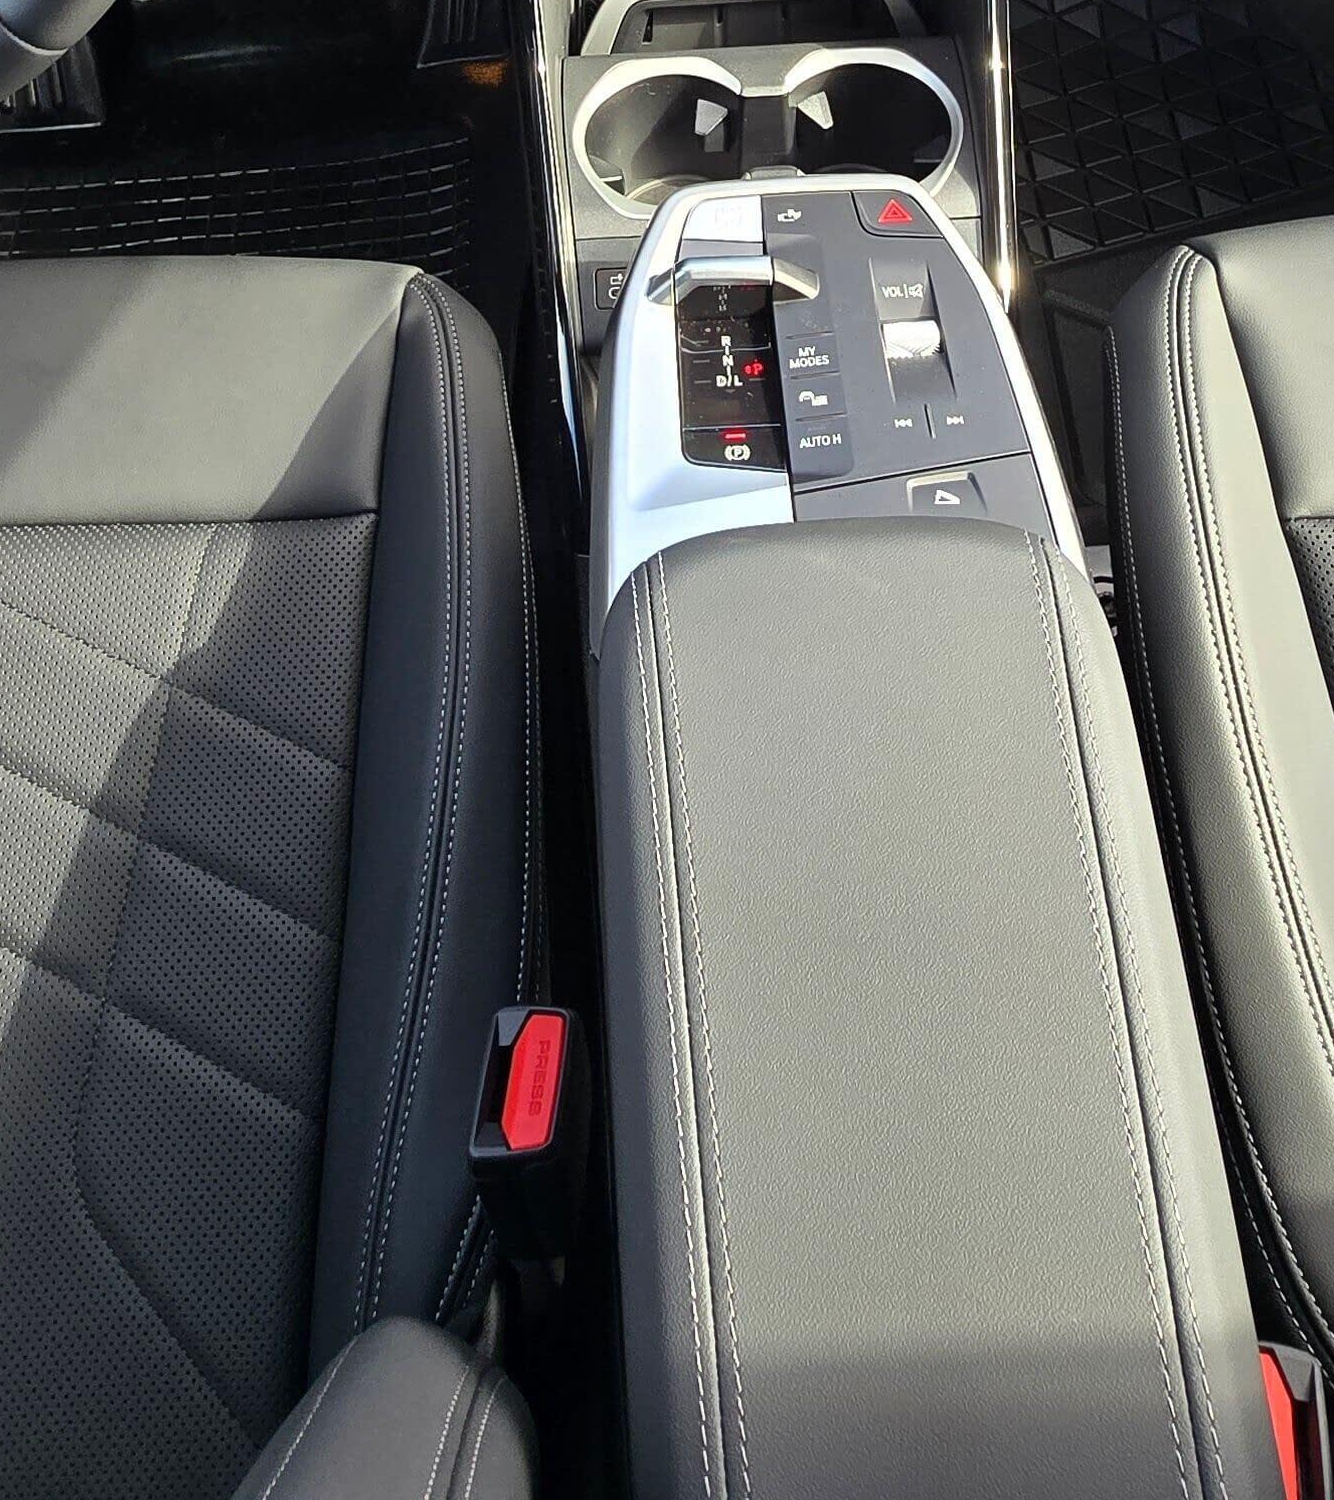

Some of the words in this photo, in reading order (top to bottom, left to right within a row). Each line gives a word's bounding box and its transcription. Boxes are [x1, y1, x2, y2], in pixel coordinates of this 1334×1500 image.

[881, 286, 904, 298] VOL
[721, 336, 731, 347] R
[798, 346, 816, 357] MY
[723, 355, 734, 366] N
[789, 355, 829, 370] MODES
[799, 435, 831, 449] AUTO
[832, 433, 842, 445] H
[527, 1039, 551, 1116] PRESS
